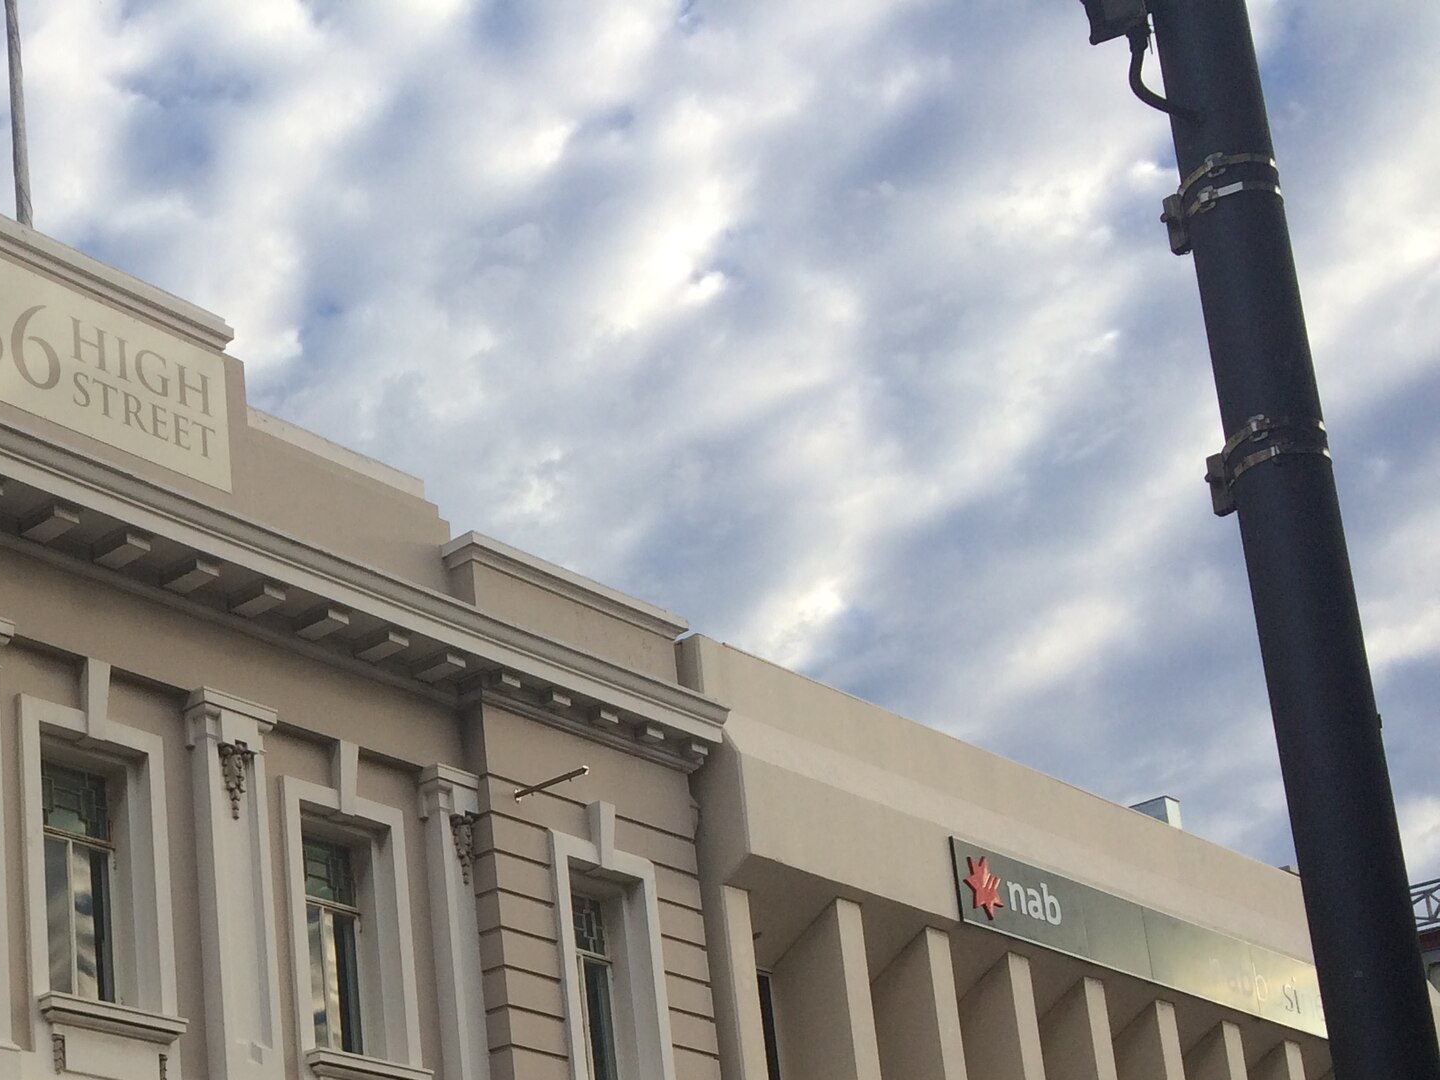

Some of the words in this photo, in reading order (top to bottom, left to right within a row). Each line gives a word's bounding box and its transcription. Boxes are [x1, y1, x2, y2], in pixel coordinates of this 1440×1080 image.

[70, 315, 215, 418] HIGH
[71, 371, 216, 458] STREET
[1007, 880, 1061, 925] nab
